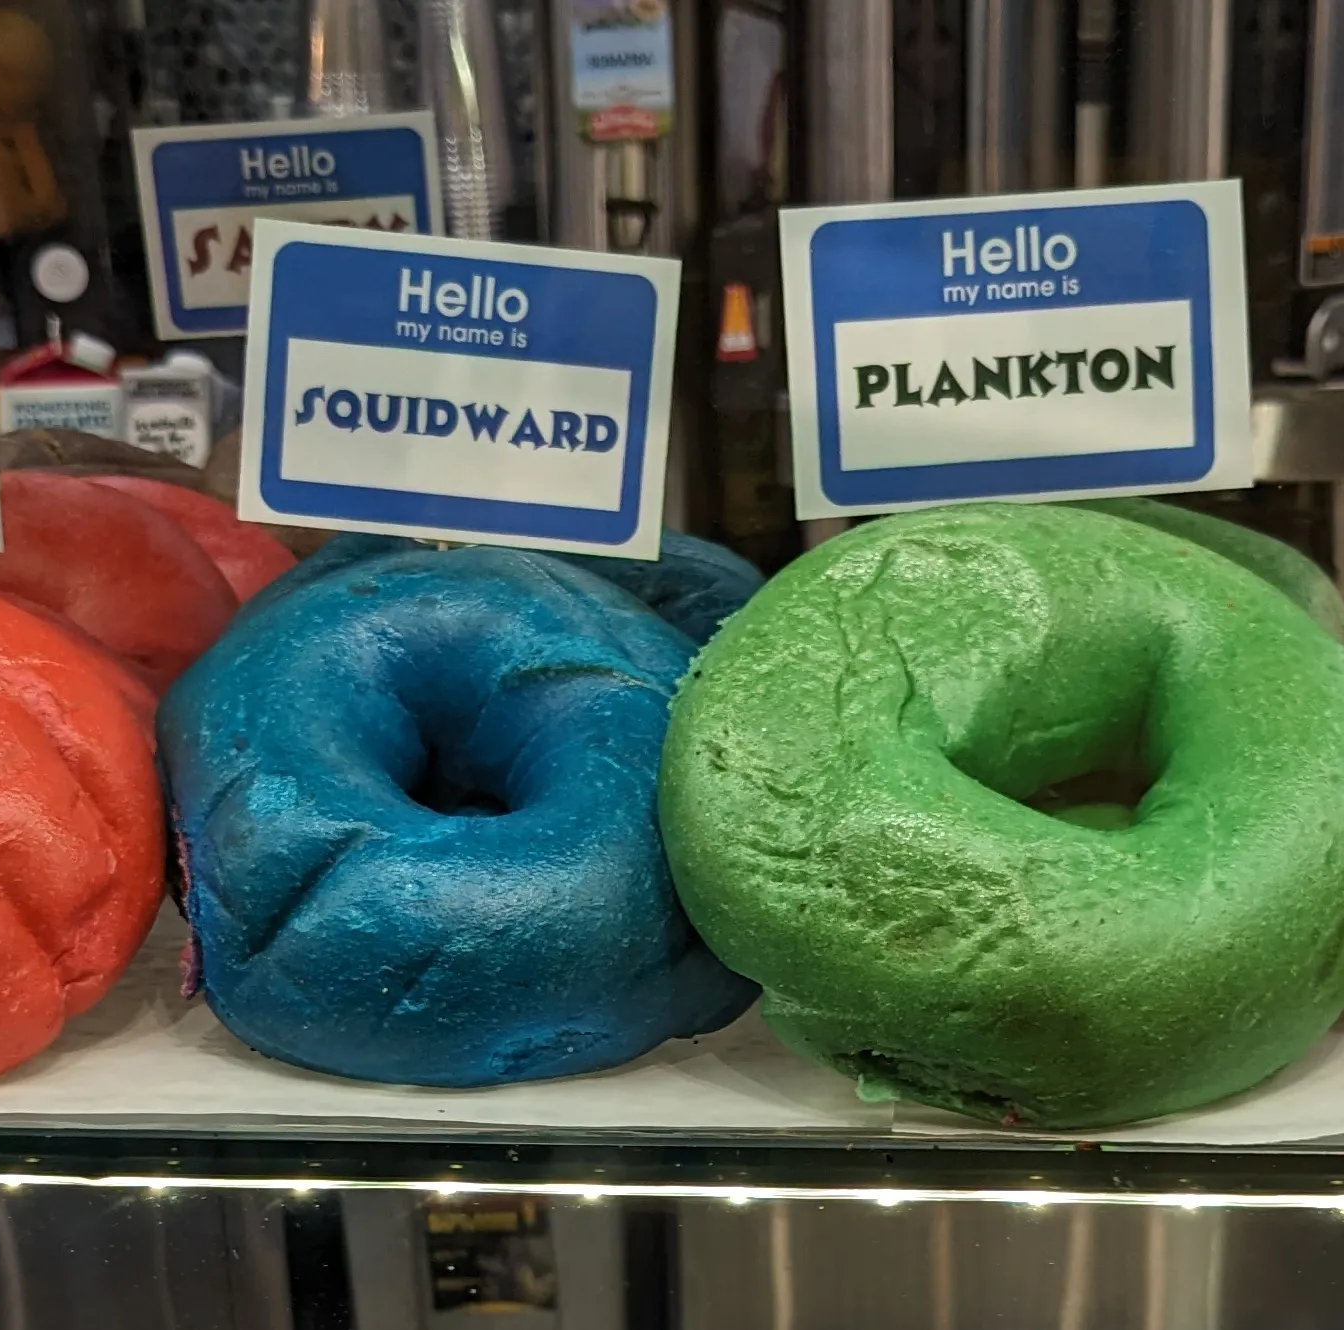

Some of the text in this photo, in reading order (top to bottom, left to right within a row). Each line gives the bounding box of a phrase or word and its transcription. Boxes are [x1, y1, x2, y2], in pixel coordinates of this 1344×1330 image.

[240, 146, 336, 181] Hello
[244, 178, 338, 199] my name is
[942, 226, 1077, 278] Hello
[399, 269, 529, 325] Hello
[943, 274, 1080, 306] my name is
[396, 317, 528, 349] my name is
[854, 345, 1176, 410] PLANKTON
[294, 385, 620, 455] SQUIDWARD
